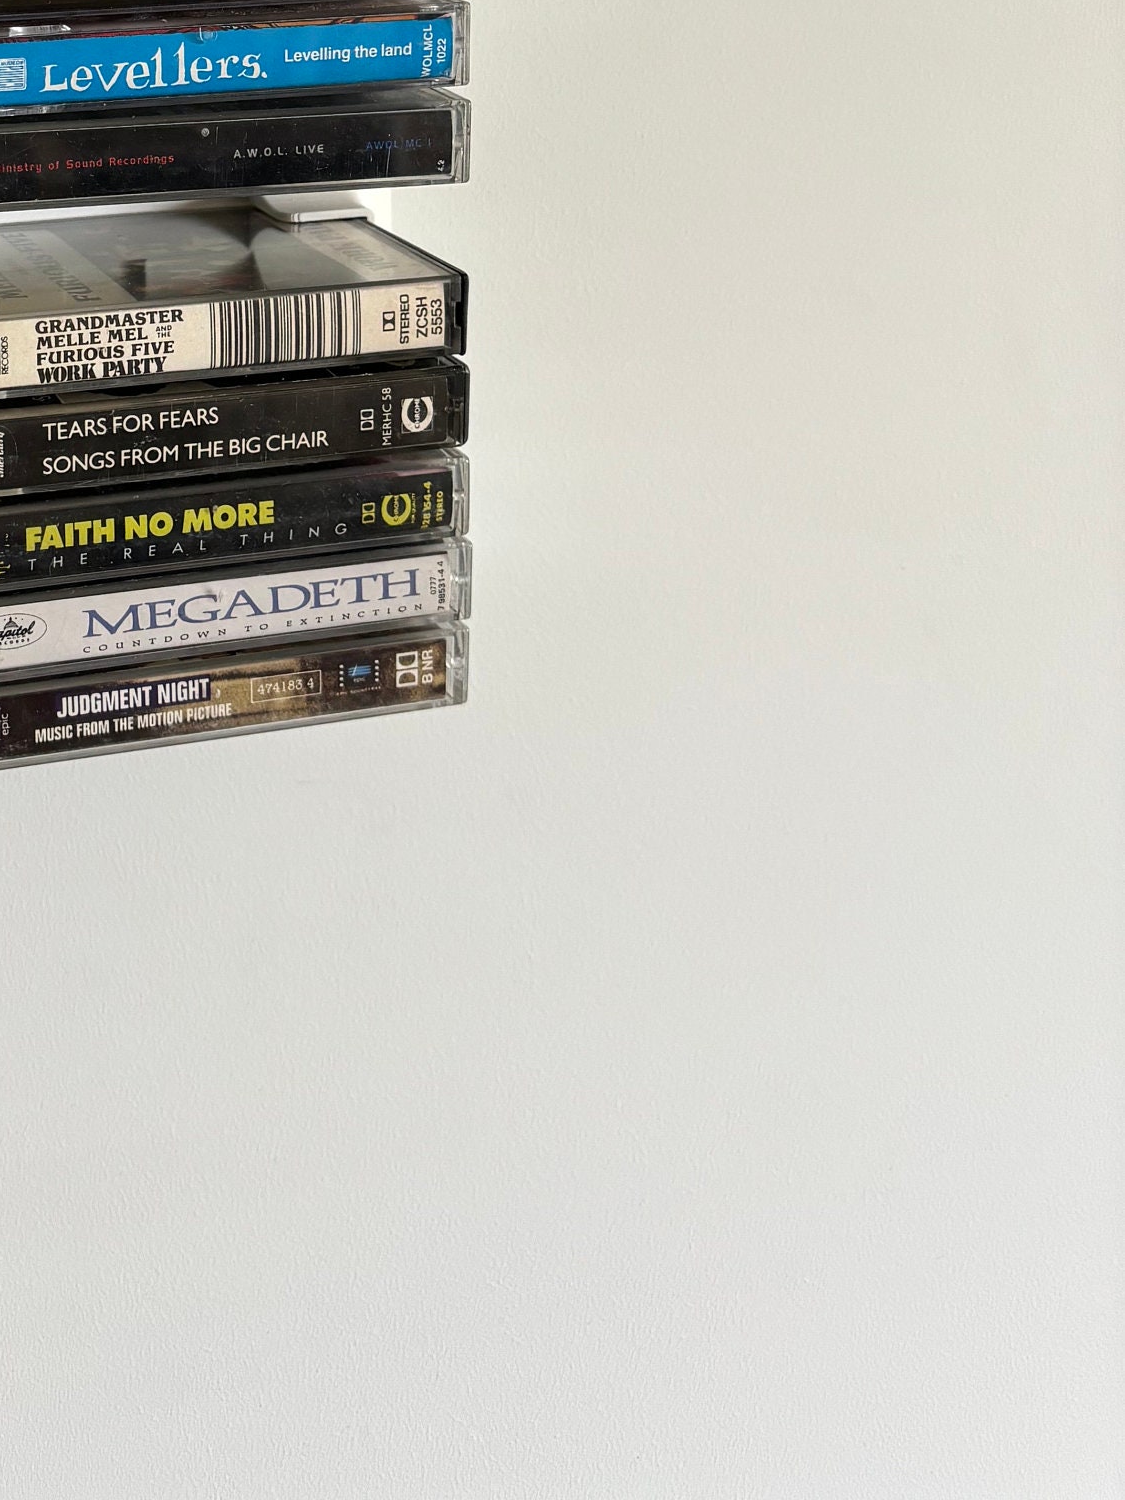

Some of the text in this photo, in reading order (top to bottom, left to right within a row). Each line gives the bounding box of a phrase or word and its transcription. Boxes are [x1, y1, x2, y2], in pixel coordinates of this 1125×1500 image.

[284, 42, 412, 63] Levelling the land
[422, 25, 433, 77] WOLMCL
[437, 38, 446, 64] 1022
[48, 161, 60, 170] of
[66, 158, 103, 169] Sound
[109, 154, 175, 166] Recordings
[295, 143, 324, 154] LIVE
[35, 309, 184, 334] GRANDMASTER
[156, 325, 173, 333] AND
[399, 294, 409, 344] STEREO
[416, 296, 428, 339] ZCSH
[431, 298, 443, 335] 5553
[36, 341, 175, 366] FURIOUS FIVE
[37, 327, 148, 350] MELLE MEL
[36, 356, 167, 384] WORK PARTY
[43, 407, 219, 441] TEARS FOR FEARS
[382, 387, 392, 446] MERHC 58
[43, 430, 329, 475] SONGS FROM THE BIG CHAIR
[436, 491, 444, 522] STEREO
[26, 518, 115, 552] FAITH
[125, 511, 173, 540] NO
[182, 500, 275, 533] MORE
[27, 523, 348, 571] THE REAL THING
[82, 568, 420, 638] MEGADETH
[83, 603, 422, 653] COUNTDOWN TO EXTINCTION
[307, 678, 314, 689] 4
[422, 649, 433, 684] B NR
[57, 678, 209, 718] JUDGMENT NIGHT
[35, 703, 232, 744] MUSIC FROM THE MOTION PICTURE
